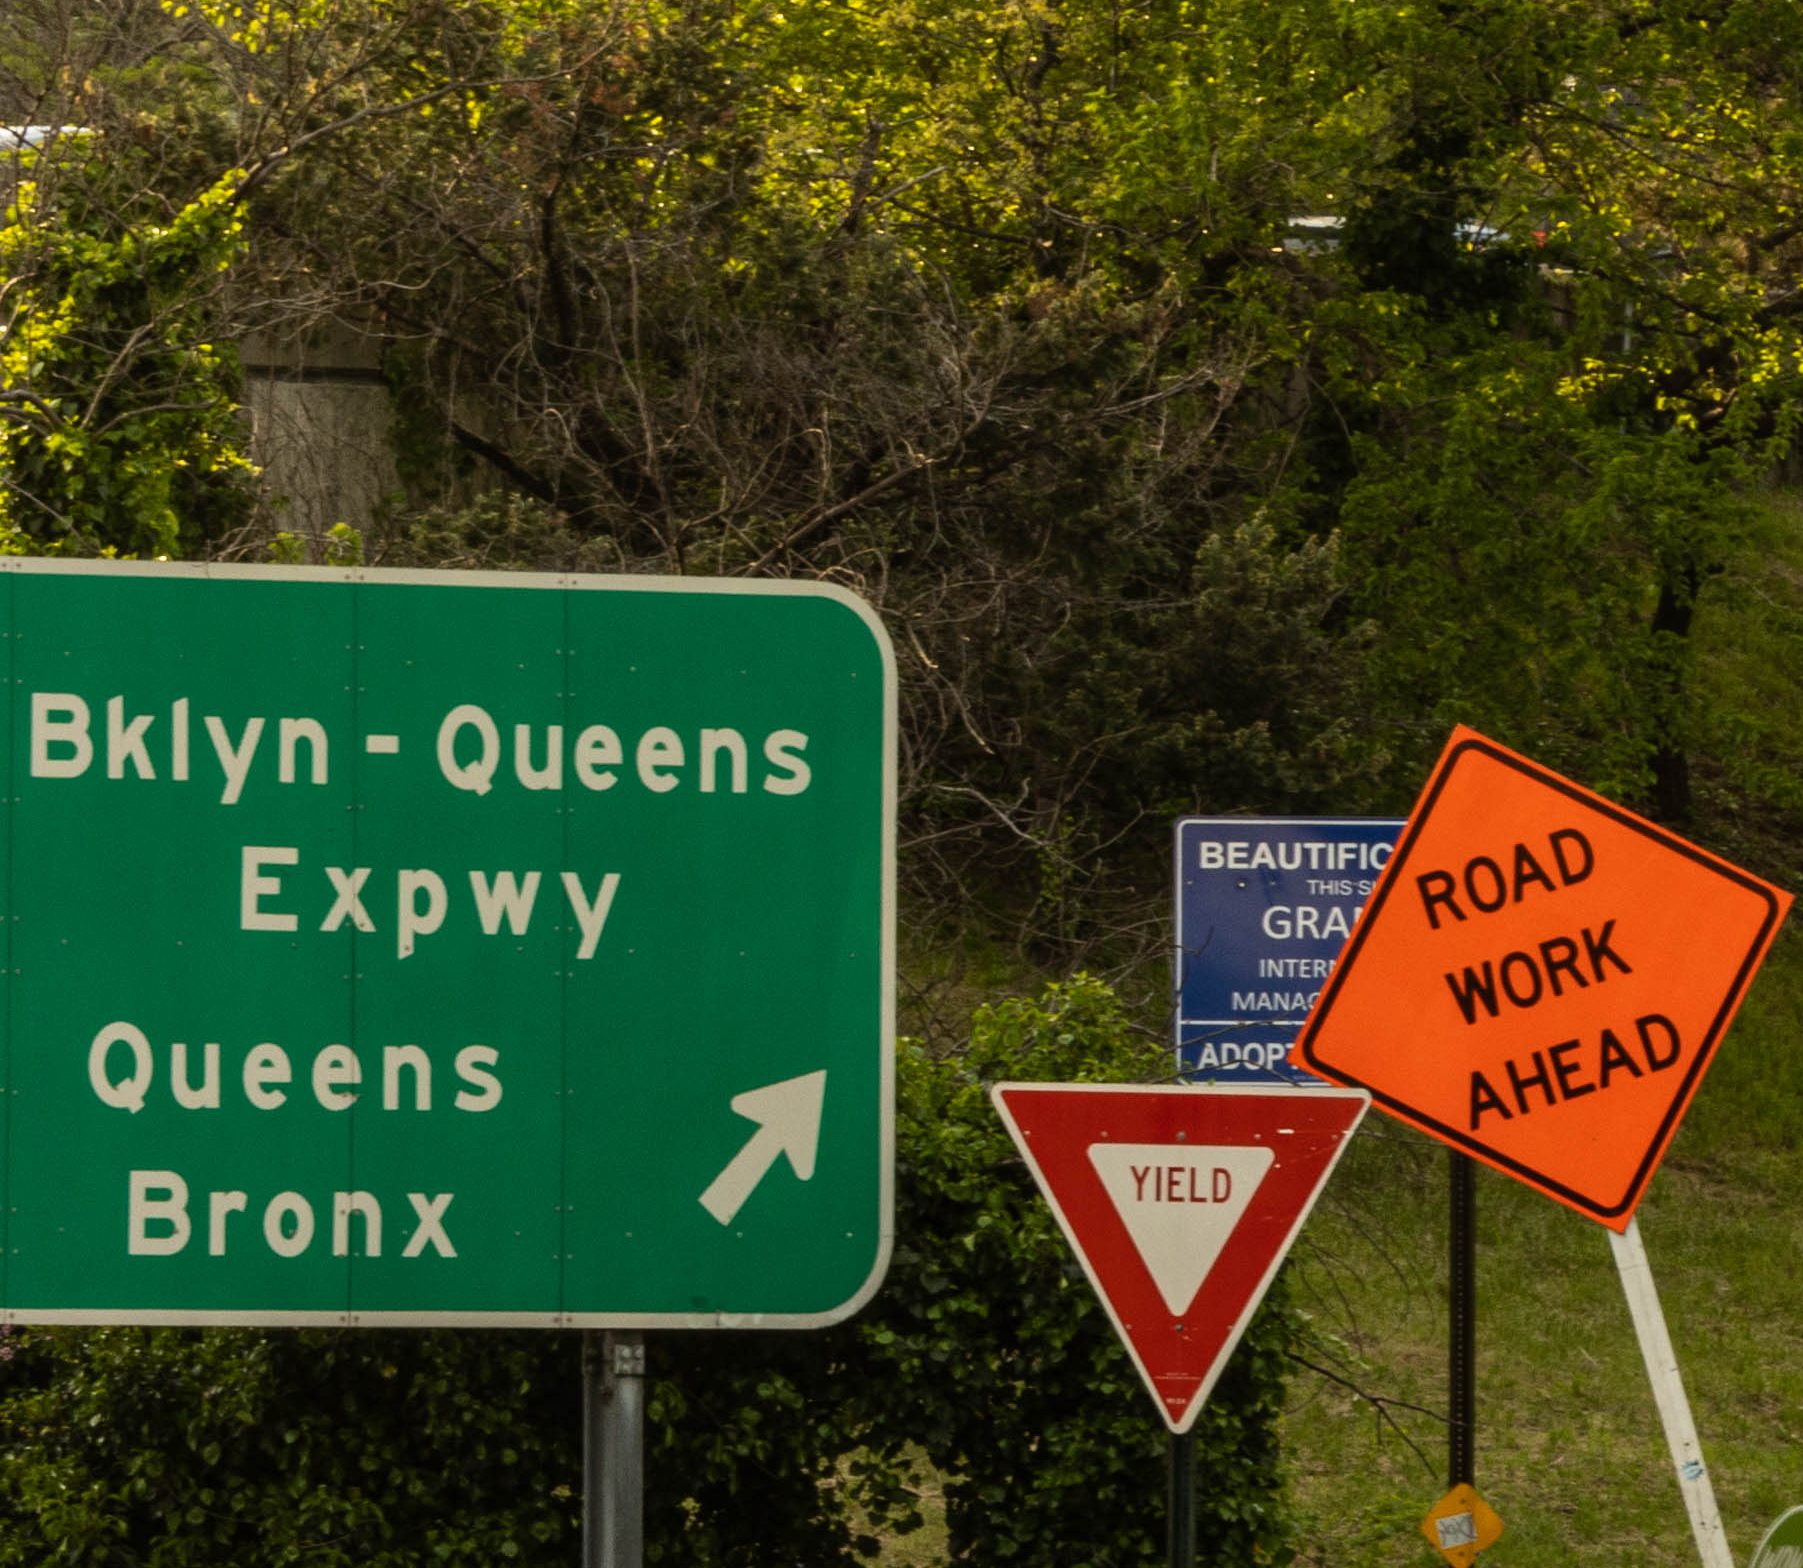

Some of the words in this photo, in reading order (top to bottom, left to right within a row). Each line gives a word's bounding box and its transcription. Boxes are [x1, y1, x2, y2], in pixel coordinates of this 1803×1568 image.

[29, 692, 329, 805] Bklyn
[436, 704, 813, 797] Queens
[240, 846, 621, 960] Expwy
[1261, 905, 1363, 940] GRA
[1307, 879, 1354, 896] THIS
[1416, 827, 1595, 930] ROAD
[1444, 919, 1633, 1026] WORK
[89, 1021, 504, 1114] Queens
[1198, 1042, 1297, 1071] ADOP
[1469, 1013, 1682, 1131] AHEAD
[127, 1170, 458, 1259] Bronx
[1130, 1165, 1232, 1204] YIELD
